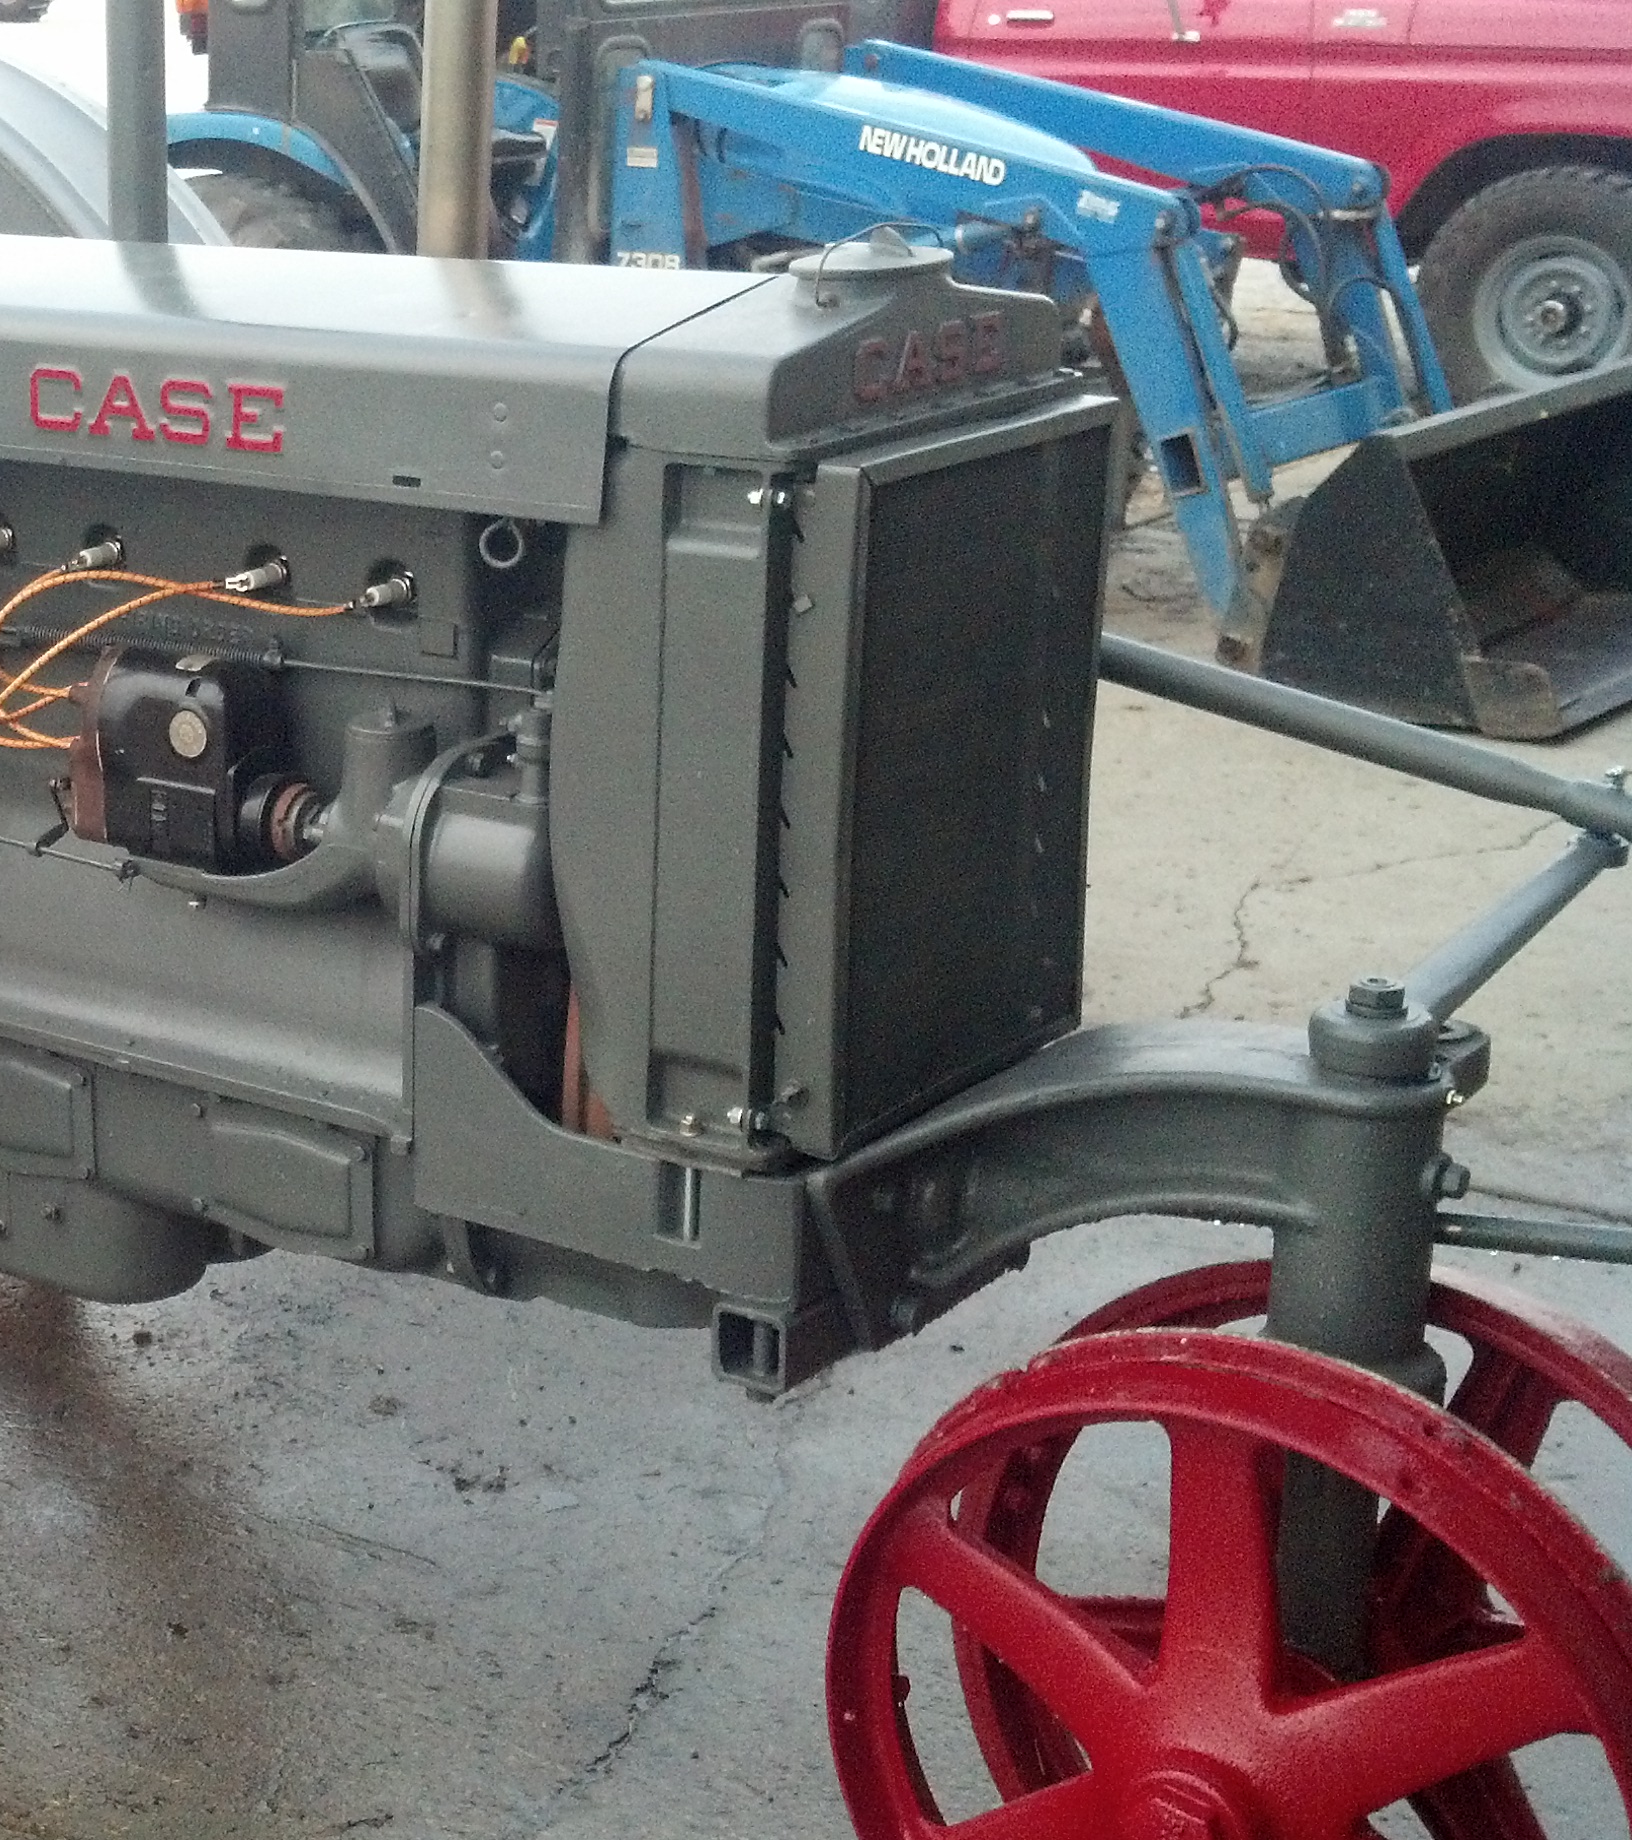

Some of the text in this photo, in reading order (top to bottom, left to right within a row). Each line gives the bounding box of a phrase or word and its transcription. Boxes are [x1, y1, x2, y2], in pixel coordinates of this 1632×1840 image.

[859, 125, 1005, 186] NEW HOLLAND
[855, 311, 1003, 400] CASE
[29, 367, 285, 453] CASE
